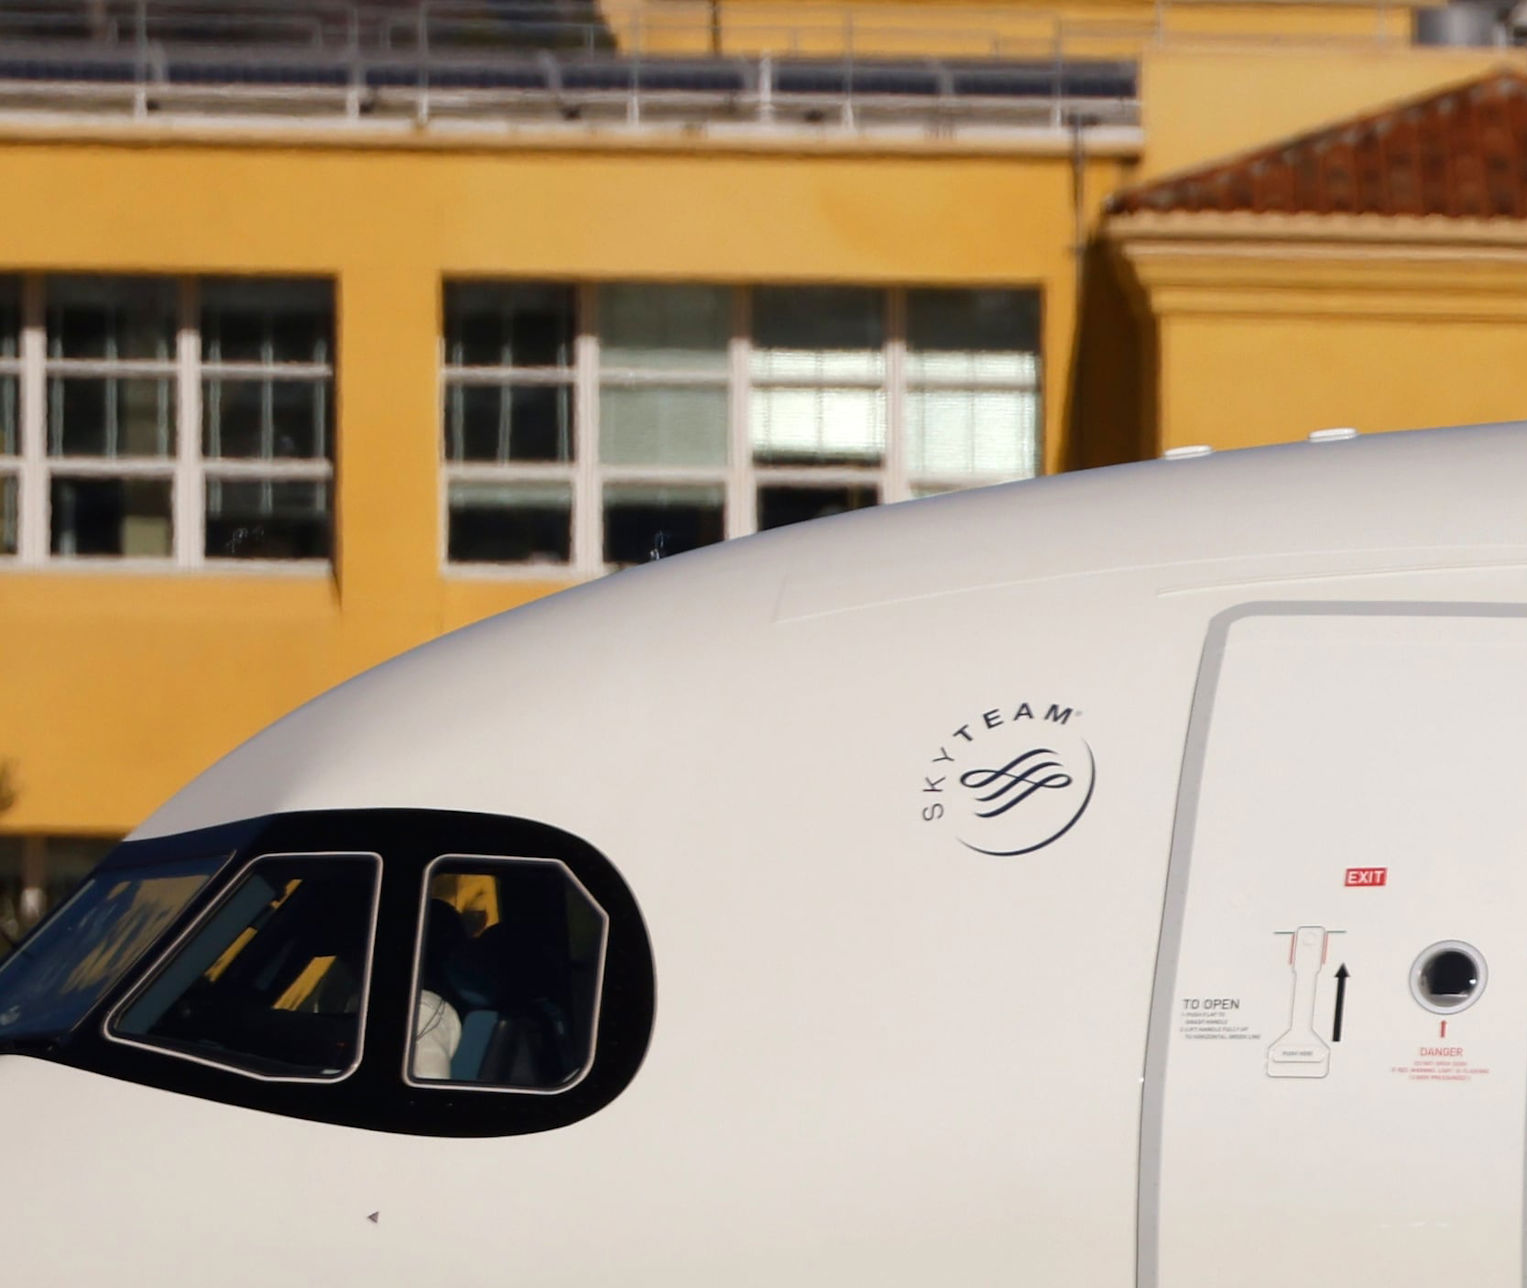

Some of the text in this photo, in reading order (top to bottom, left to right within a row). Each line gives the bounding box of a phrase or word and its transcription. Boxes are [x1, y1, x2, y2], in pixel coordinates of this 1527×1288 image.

[922, 702, 1074, 822] SKYTEAM
[1347, 869, 1385, 885] EXIT
[1183, 998, 1240, 1010] TO OPEN
[1419, 1047, 1464, 1057] DANGER
